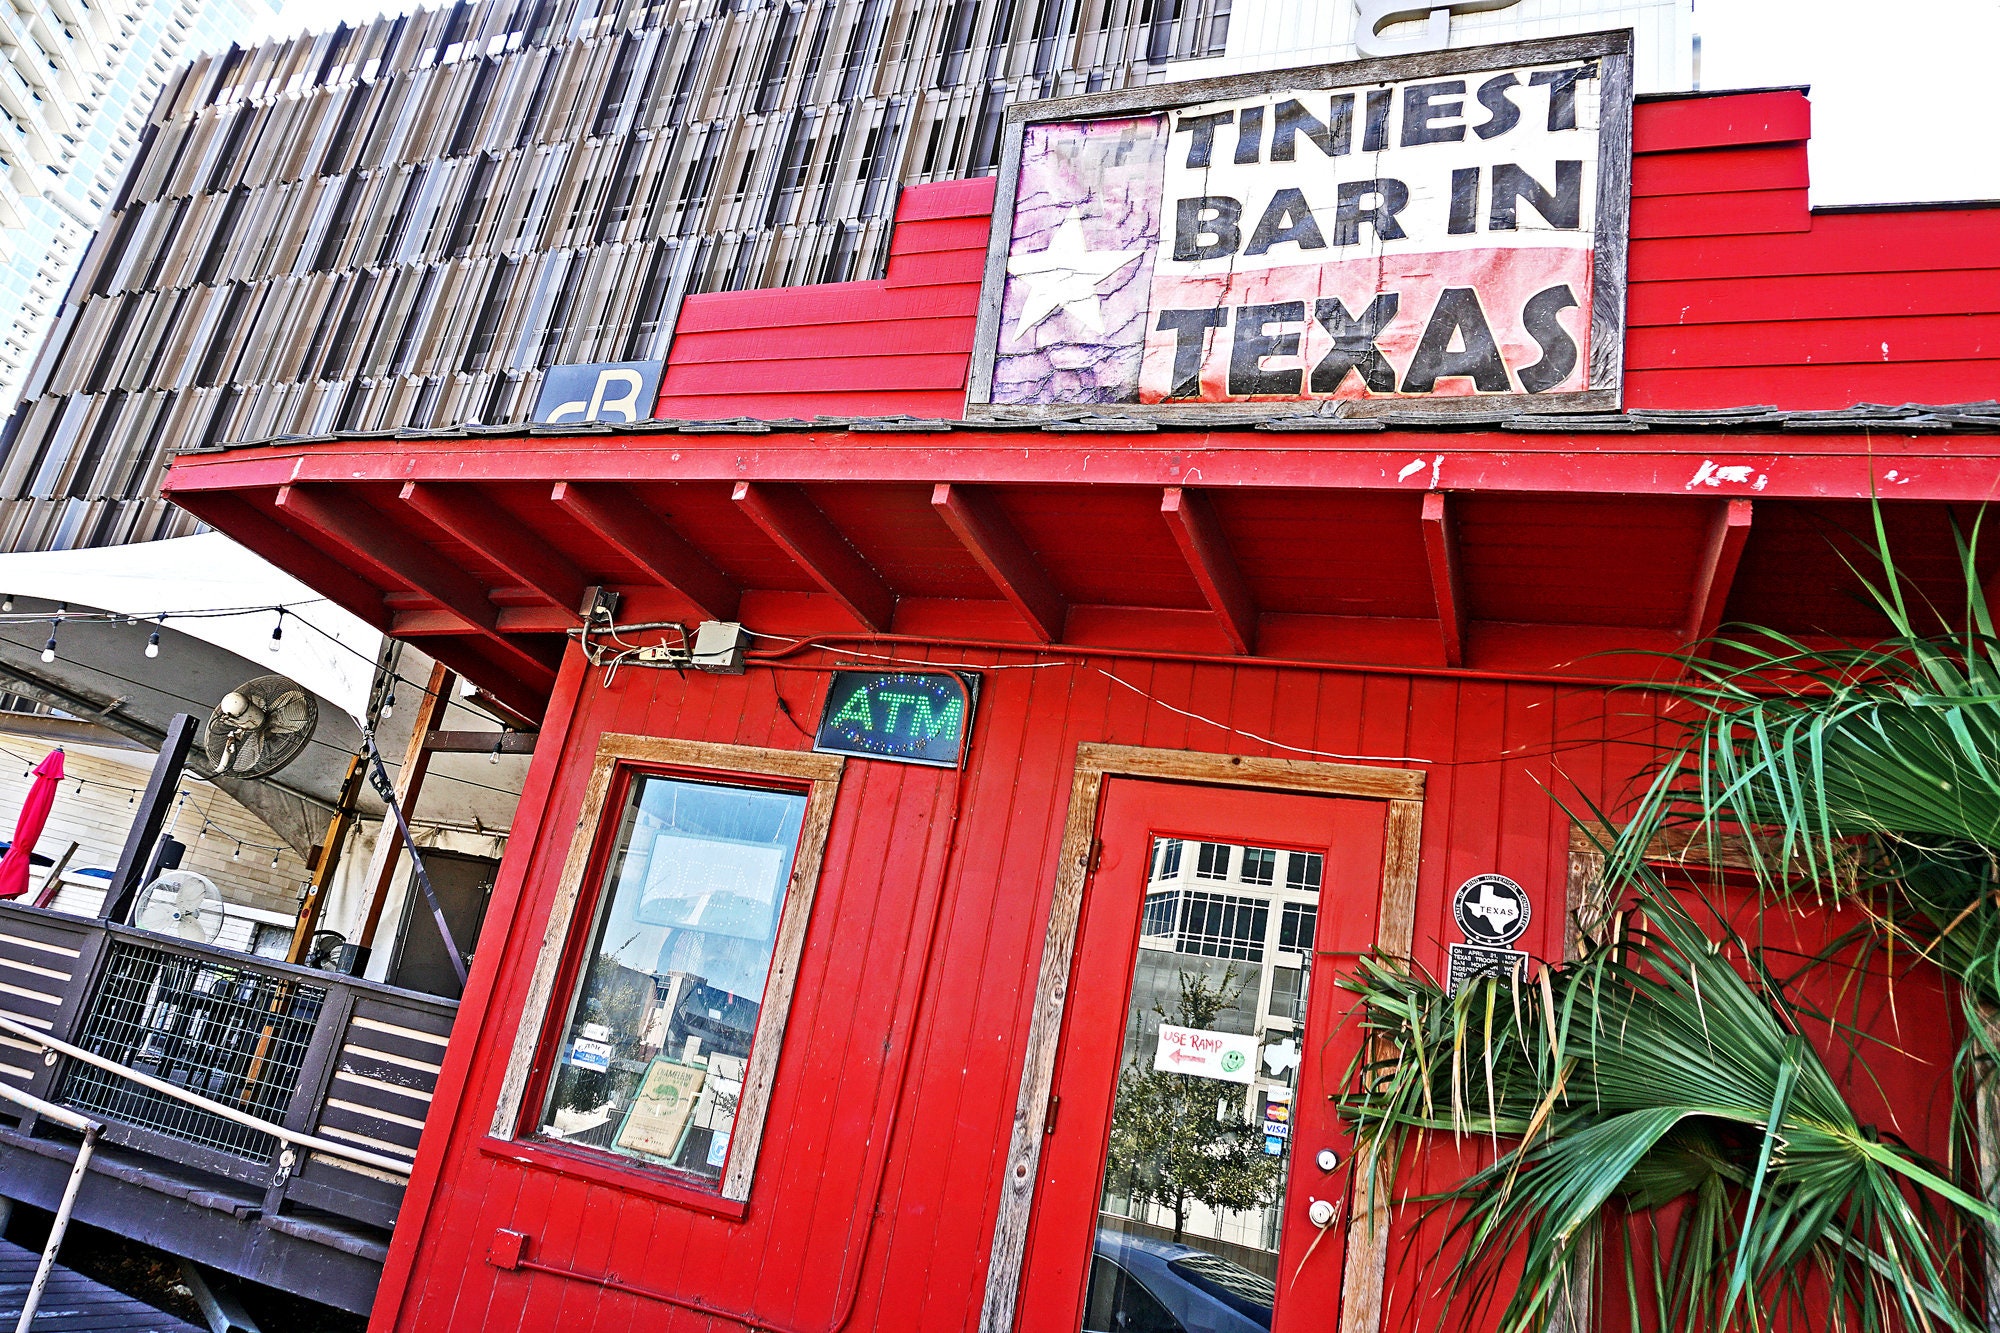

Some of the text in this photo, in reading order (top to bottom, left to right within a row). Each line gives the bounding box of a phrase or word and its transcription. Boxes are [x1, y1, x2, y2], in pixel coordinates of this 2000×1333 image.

[1175, 62, 1599, 170] TINIEST
[1172, 159, 1582, 262] BAR IN
[1156, 284, 1581, 398] TEXAS
[830, 686, 962, 741] ATM
[650, 857, 774, 912] OPEN
[1480, 906, 1514, 917] TEXAS
[1163, 1030, 1223, 1053] USE RAMP
[1266, 1124, 1287, 1134] VISA
